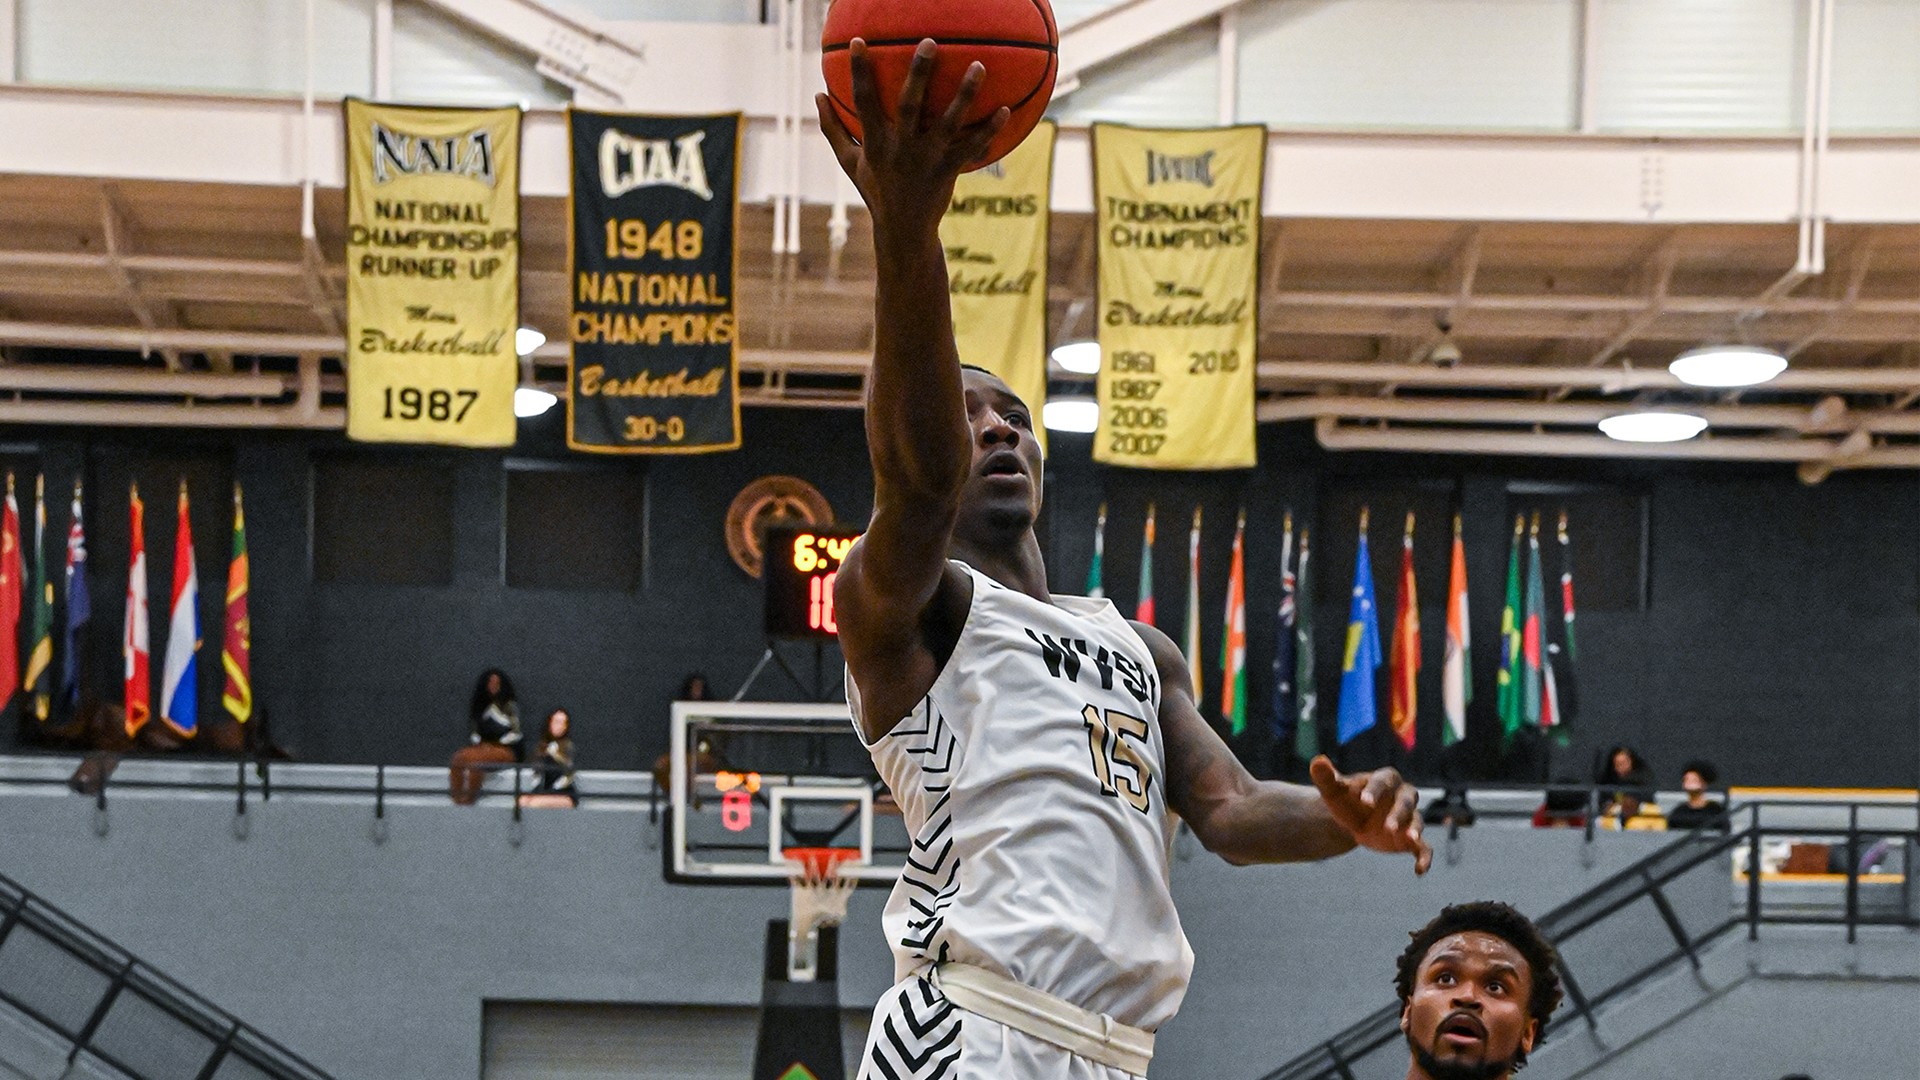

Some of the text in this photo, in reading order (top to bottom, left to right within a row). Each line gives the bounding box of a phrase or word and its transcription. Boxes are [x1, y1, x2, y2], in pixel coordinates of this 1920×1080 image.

[372, 121, 496, 188] NAIA
[598, 127, 714, 201] CIAA
[375, 200, 489, 225] NATIONAL
[1107, 196, 1253, 225] TOURNAMENT
[349, 224, 516, 251] CHAMPIONSHIP
[605, 217, 703, 260] 1948
[1110, 225, 1249, 250] CHAMPIONS
[579, 271, 727, 306] NATIONAL
[572, 311, 734, 345] CHAMPIONS
[1105, 299, 1247, 328] Basketball
[358, 328, 506, 357] Basketball
[579, 363, 726, 398] Basketball
[1110, 379, 1162, 401] 1987
[383, 386, 479, 423] 1987
[1110, 405, 1168, 428] 2006
[623, 415, 685, 441] 30-0
[1109, 432, 1166, 455] 2007
[794, 533, 861, 572] 6:4
[1081, 703, 1152, 814] 15
